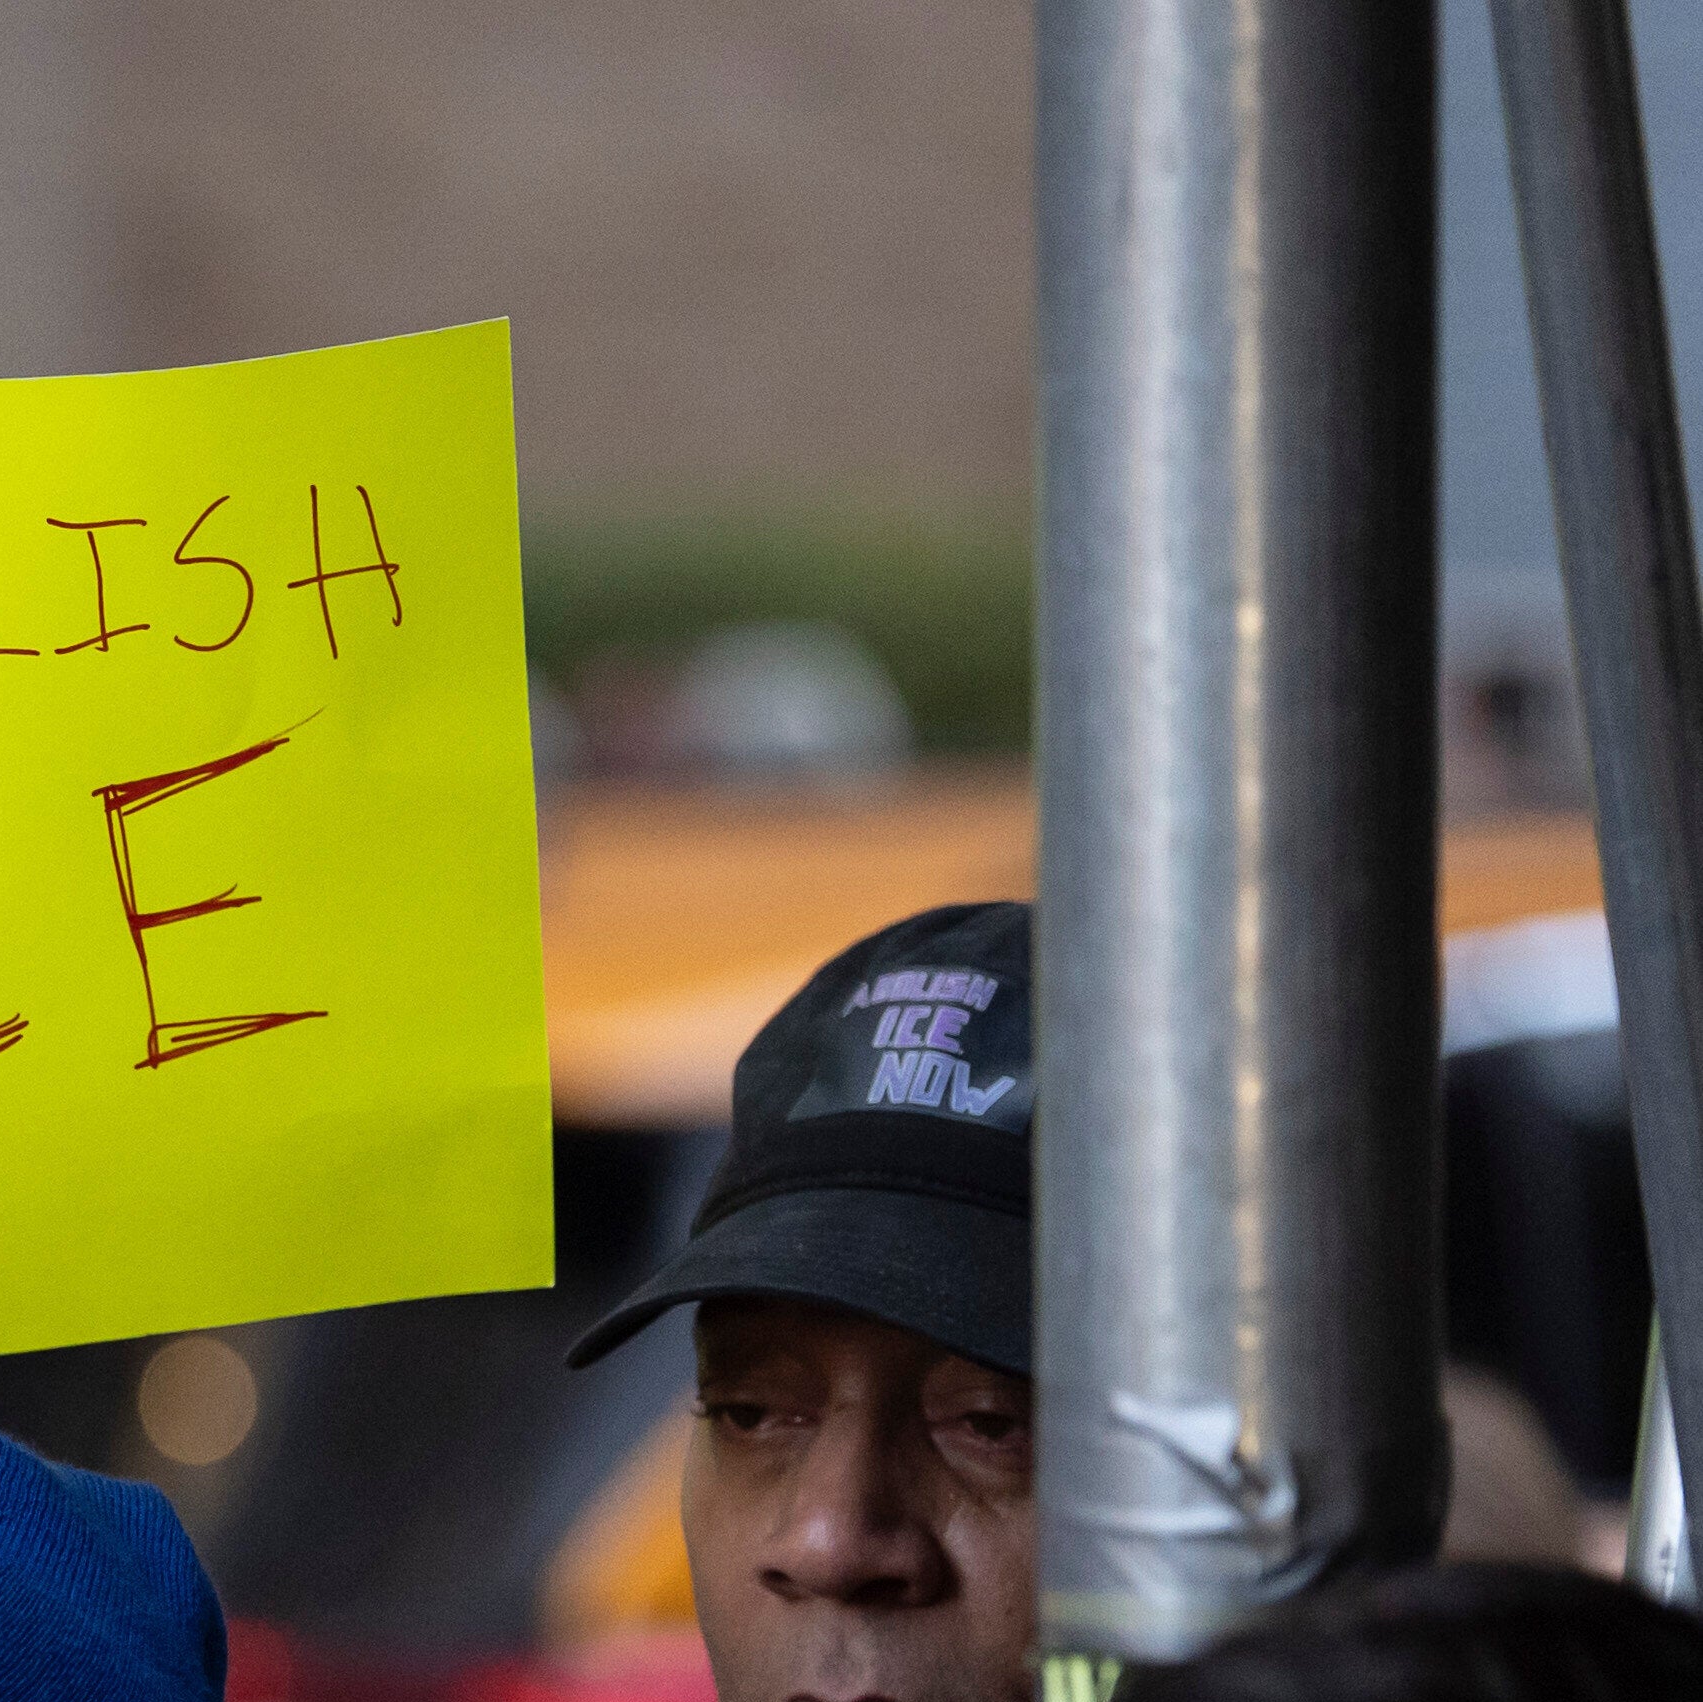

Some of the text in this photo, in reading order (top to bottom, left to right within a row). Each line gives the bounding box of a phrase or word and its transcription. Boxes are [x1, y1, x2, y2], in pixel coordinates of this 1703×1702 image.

[842, 970, 998, 1018] ABOLISH
[872, 1004, 971, 1055] ICE
[866, 1050, 1017, 1116] NOW
